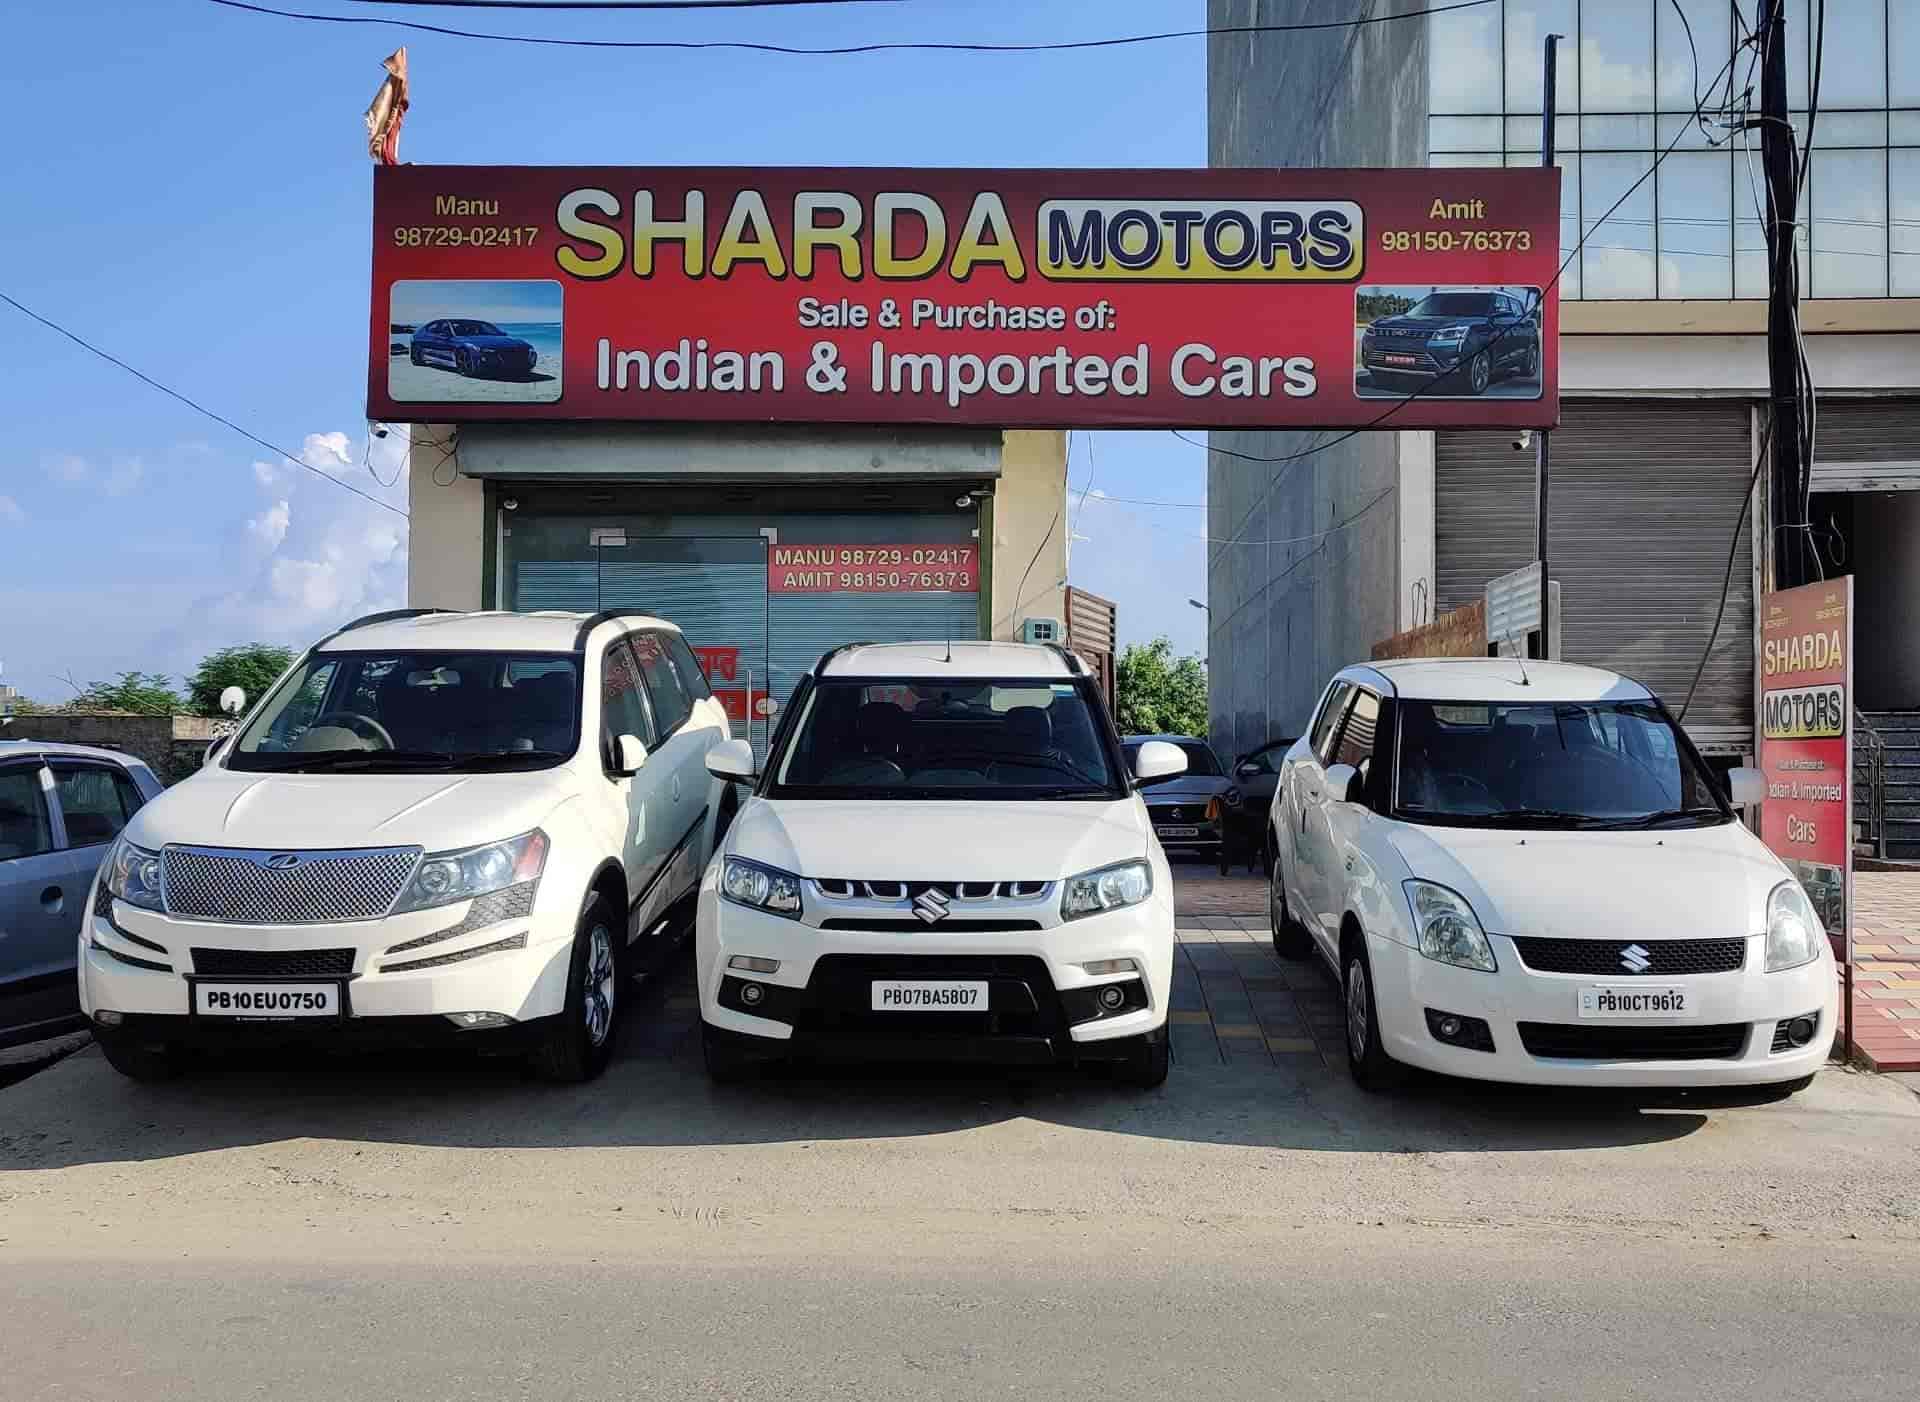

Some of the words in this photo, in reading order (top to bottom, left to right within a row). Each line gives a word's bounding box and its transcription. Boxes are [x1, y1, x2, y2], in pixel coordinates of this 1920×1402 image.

[435, 195, 499, 215] Manu
[1429, 198, 1485, 220] Amit
[394, 226, 539, 247] 98729-02417
[555, 188, 1026, 281] SHARDA
[1047, 207, 1355, 270] MOTORS
[1382, 230, 1532, 252] 98150-76373
[798, 297, 869, 328] Sale
[877, 299, 902, 328] &
[912, 299, 1066, 329] Purchase
[1075, 300, 1116, 330] of:
[597, 338, 785, 393] Indian
[805, 340, 848, 393] &
[871, 340, 1150, 407] Imported
[1170, 344, 1318, 399] Cars
[775, 549, 836, 566] MANU
[840, 549, 972, 566] 98729-02417
[783, 572, 833, 588] AMIT
[840, 572, 971, 588] 98150-76373
[1765, 629, 1842, 675] SHARDA
[1766, 691, 1841, 733] MOTORS
[1787, 814, 1816, 843] Cars
[207, 991, 328, 1009] PB10EU0750
[883, 989, 978, 1005] PB07BA5807
[1598, 994, 1685, 1011] PB10CT9612
